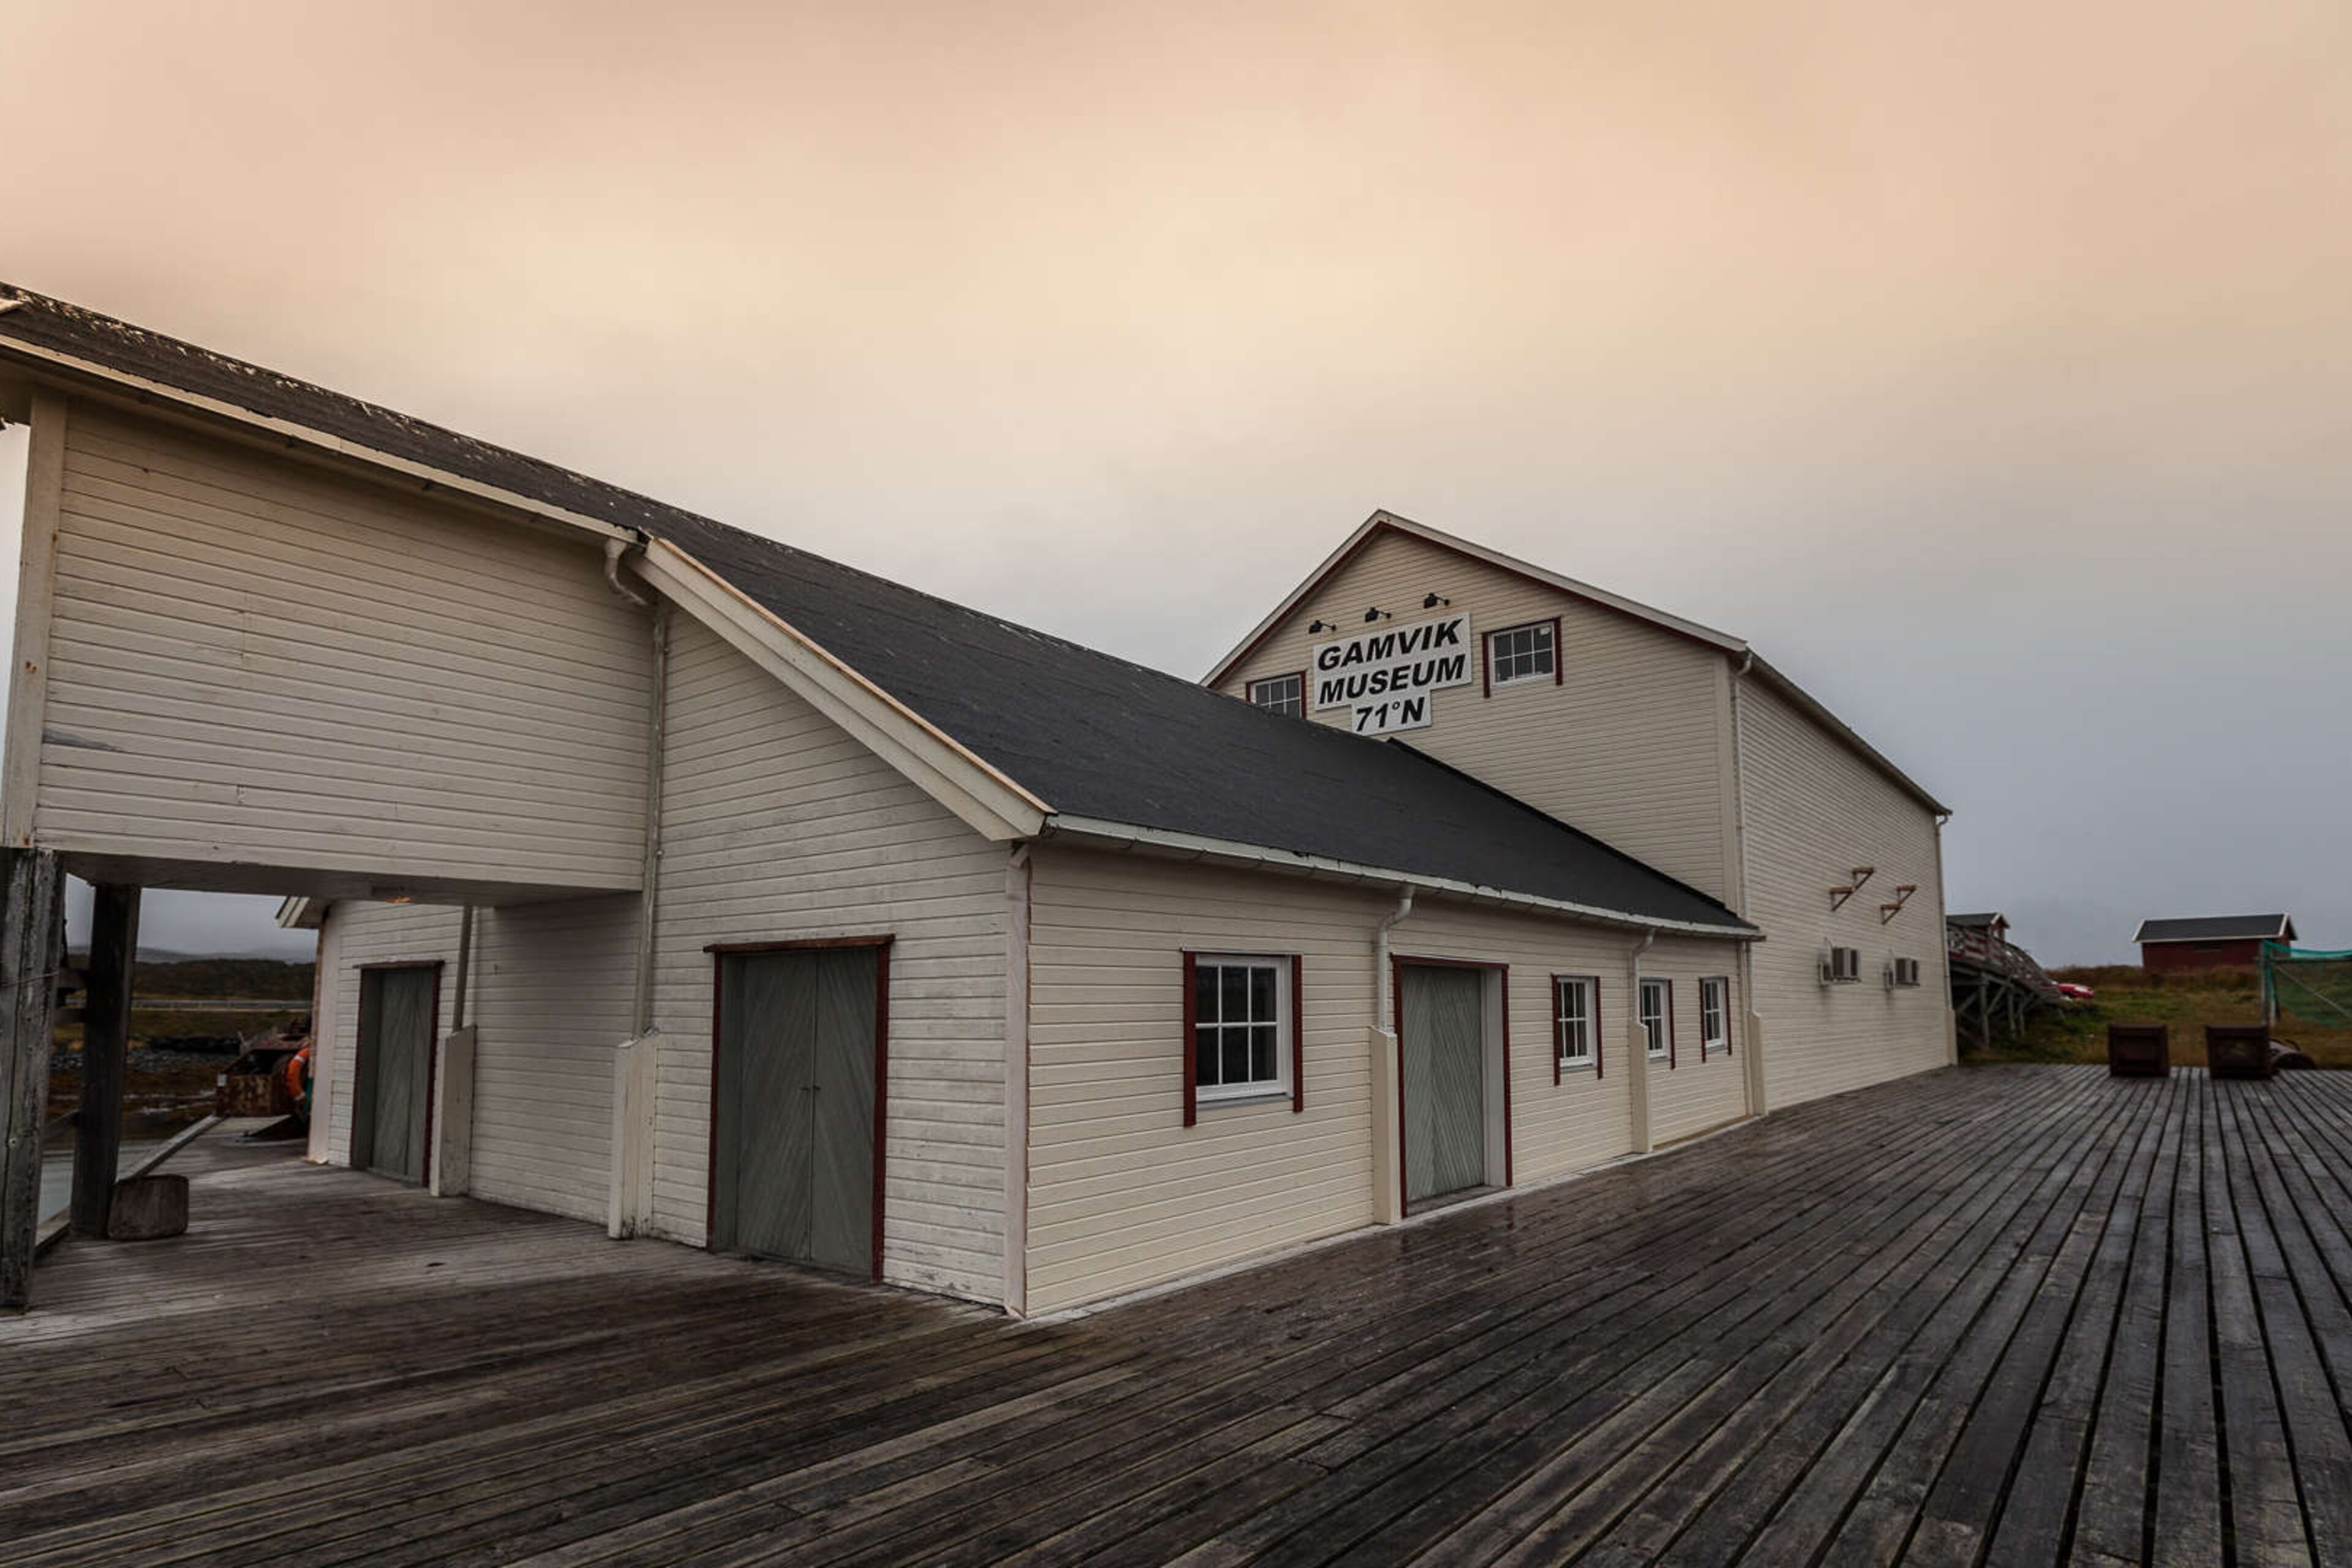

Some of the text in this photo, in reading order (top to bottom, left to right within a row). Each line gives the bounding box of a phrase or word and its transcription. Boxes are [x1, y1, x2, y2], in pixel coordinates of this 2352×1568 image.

[1317, 618, 1464, 671] GAMVIK
[1319, 655, 1466, 704] MUSEUM
[1355, 696, 1425, 732] 71°N
